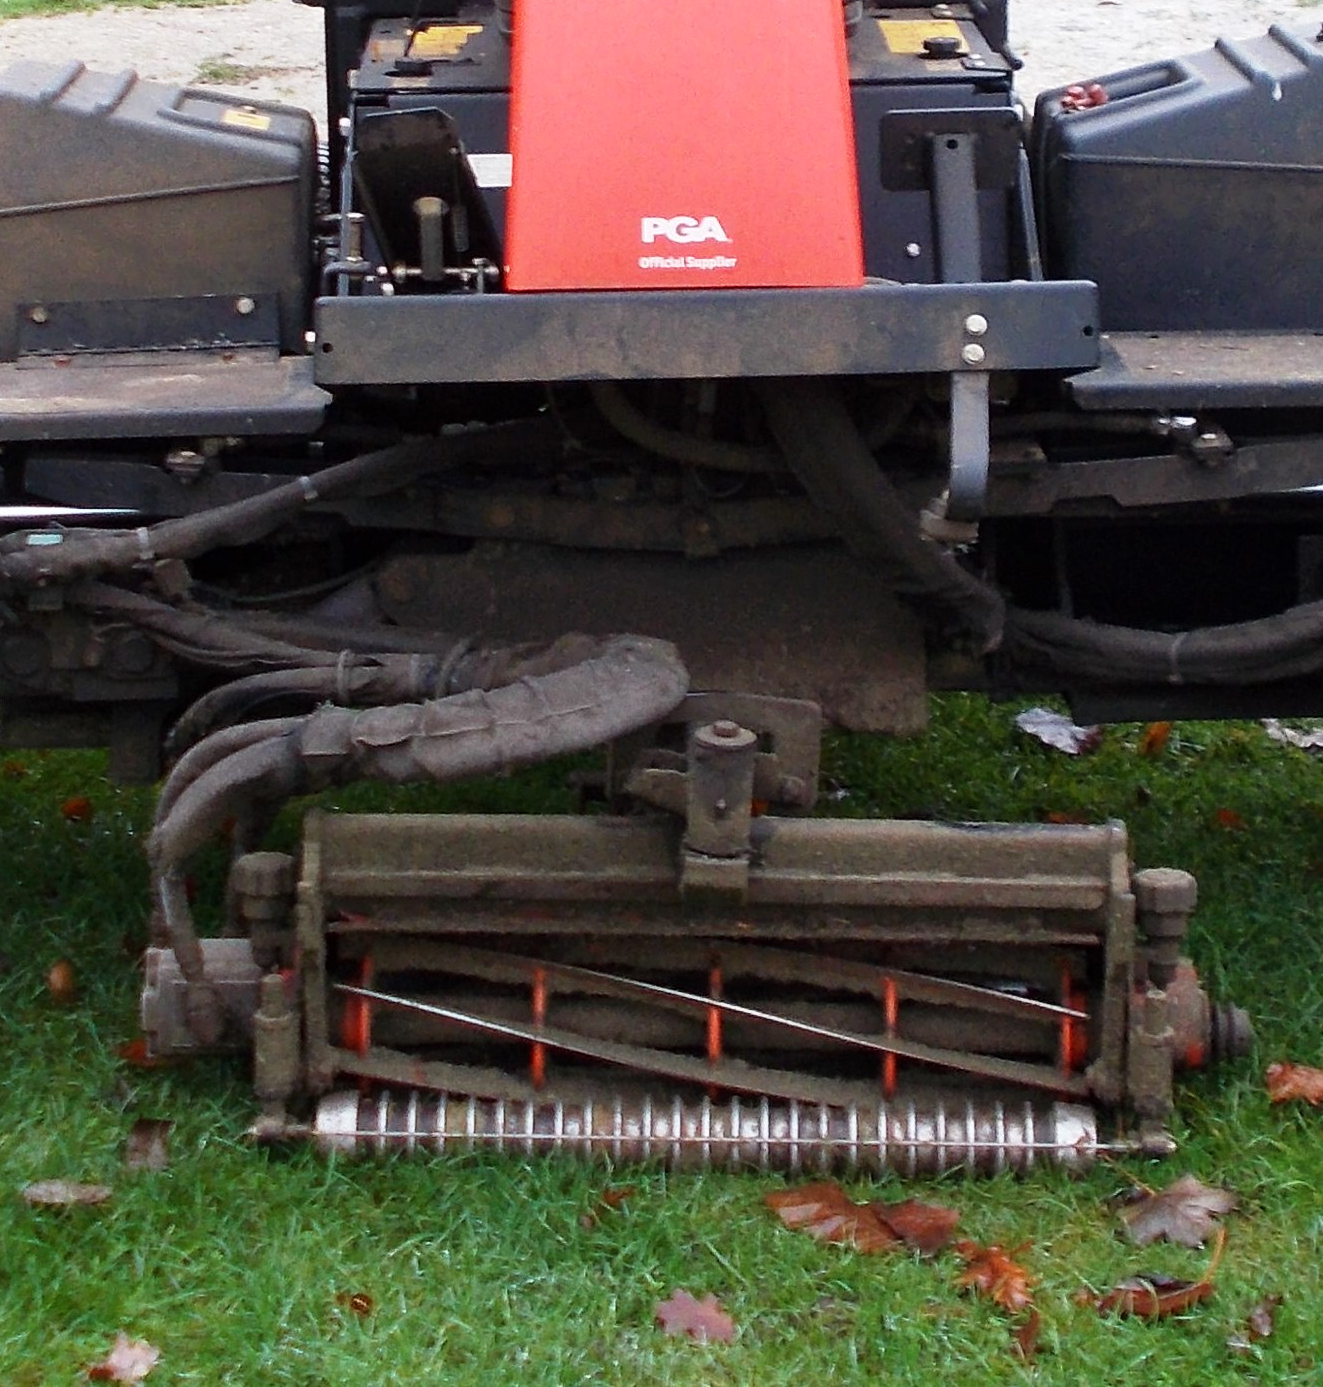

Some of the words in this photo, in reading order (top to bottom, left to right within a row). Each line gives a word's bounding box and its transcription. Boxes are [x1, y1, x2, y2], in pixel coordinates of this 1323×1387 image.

[641, 215, 728, 243] PGA
[638, 255, 684, 269] Official
[685, 255, 737, 270] Supplier
